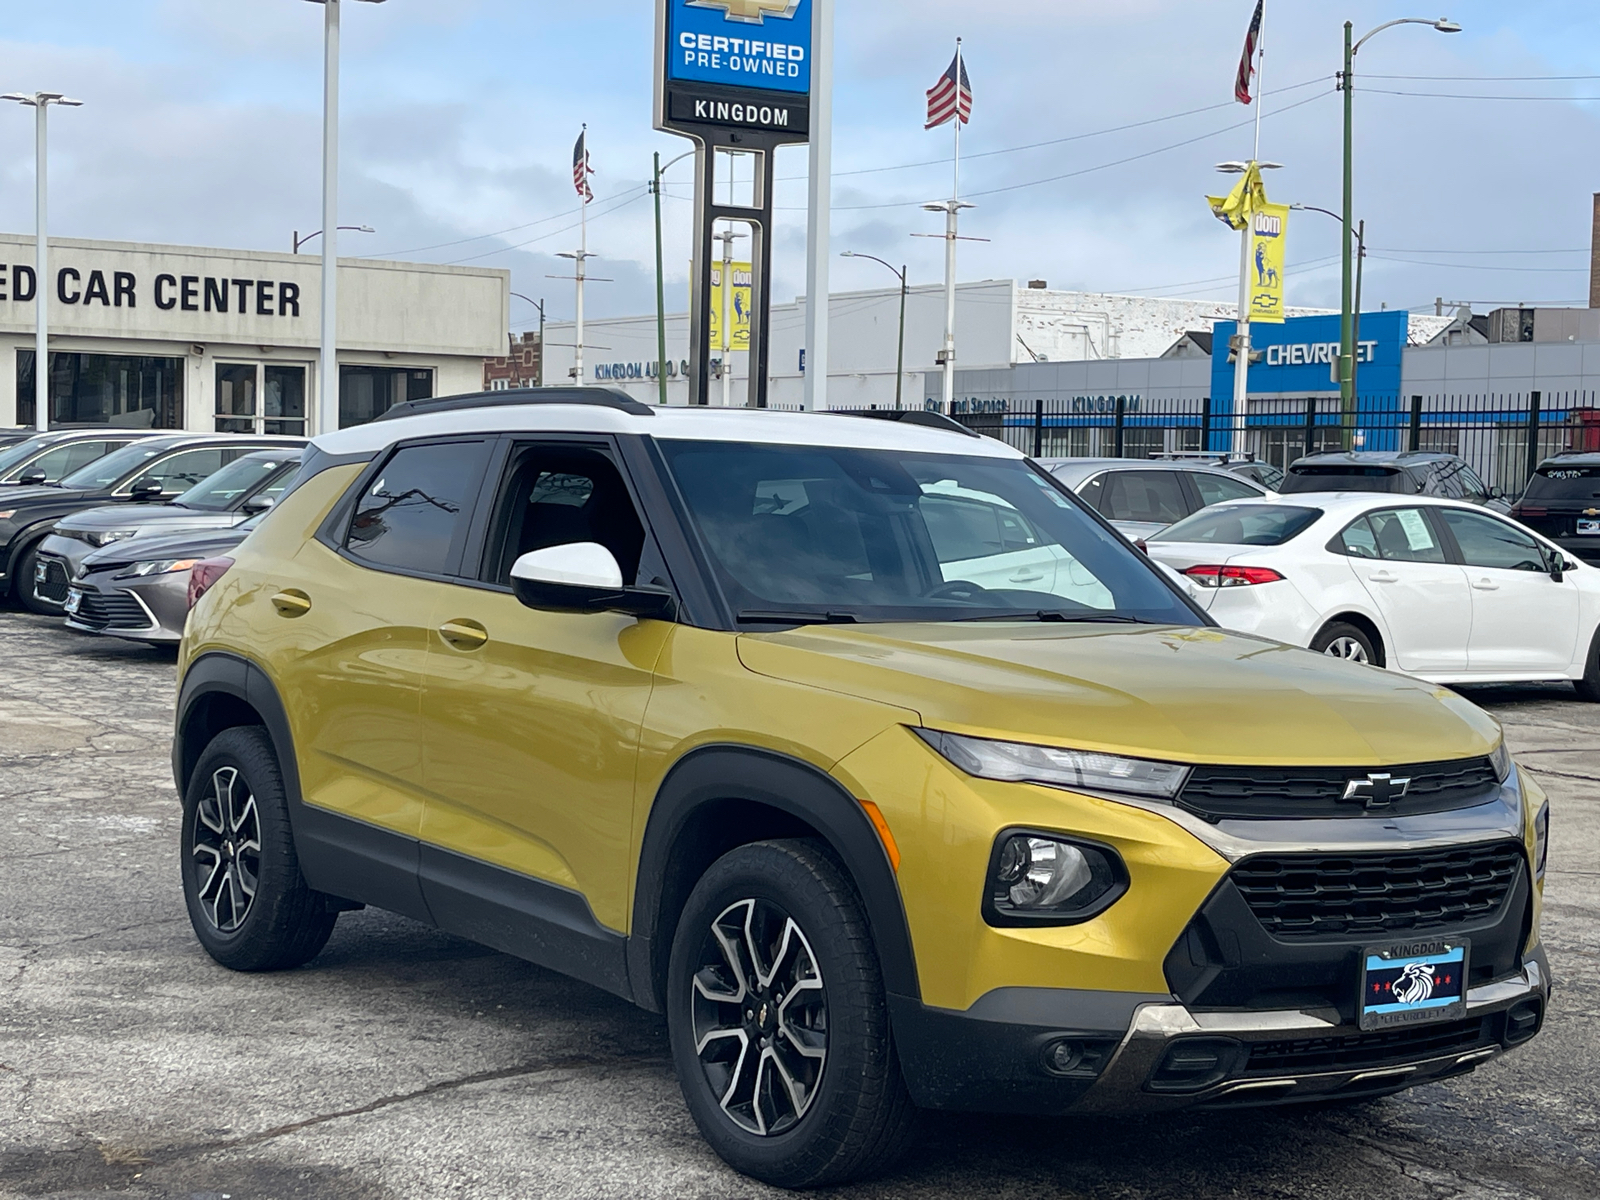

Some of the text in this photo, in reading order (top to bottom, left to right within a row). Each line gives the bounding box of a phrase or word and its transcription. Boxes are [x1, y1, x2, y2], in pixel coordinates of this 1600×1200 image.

[680, 32, 804, 61] CERTIFIED
[685, 51, 799, 78] PRE-OWNED
[695, 100, 788, 126] KINGDOM
[1254, 210, 1281, 238] dom
[57, 267, 136, 307] CAR
[154, 273, 300, 316] CENTER
[1266, 340, 1378, 365] CHEVROET
[594, 361, 642, 380] KINGDOM
[645, 360, 673, 378] AUO
[1390, 941, 1446, 957] KINGDOM
[1384, 1009, 1440, 1024] CHEVROLET
